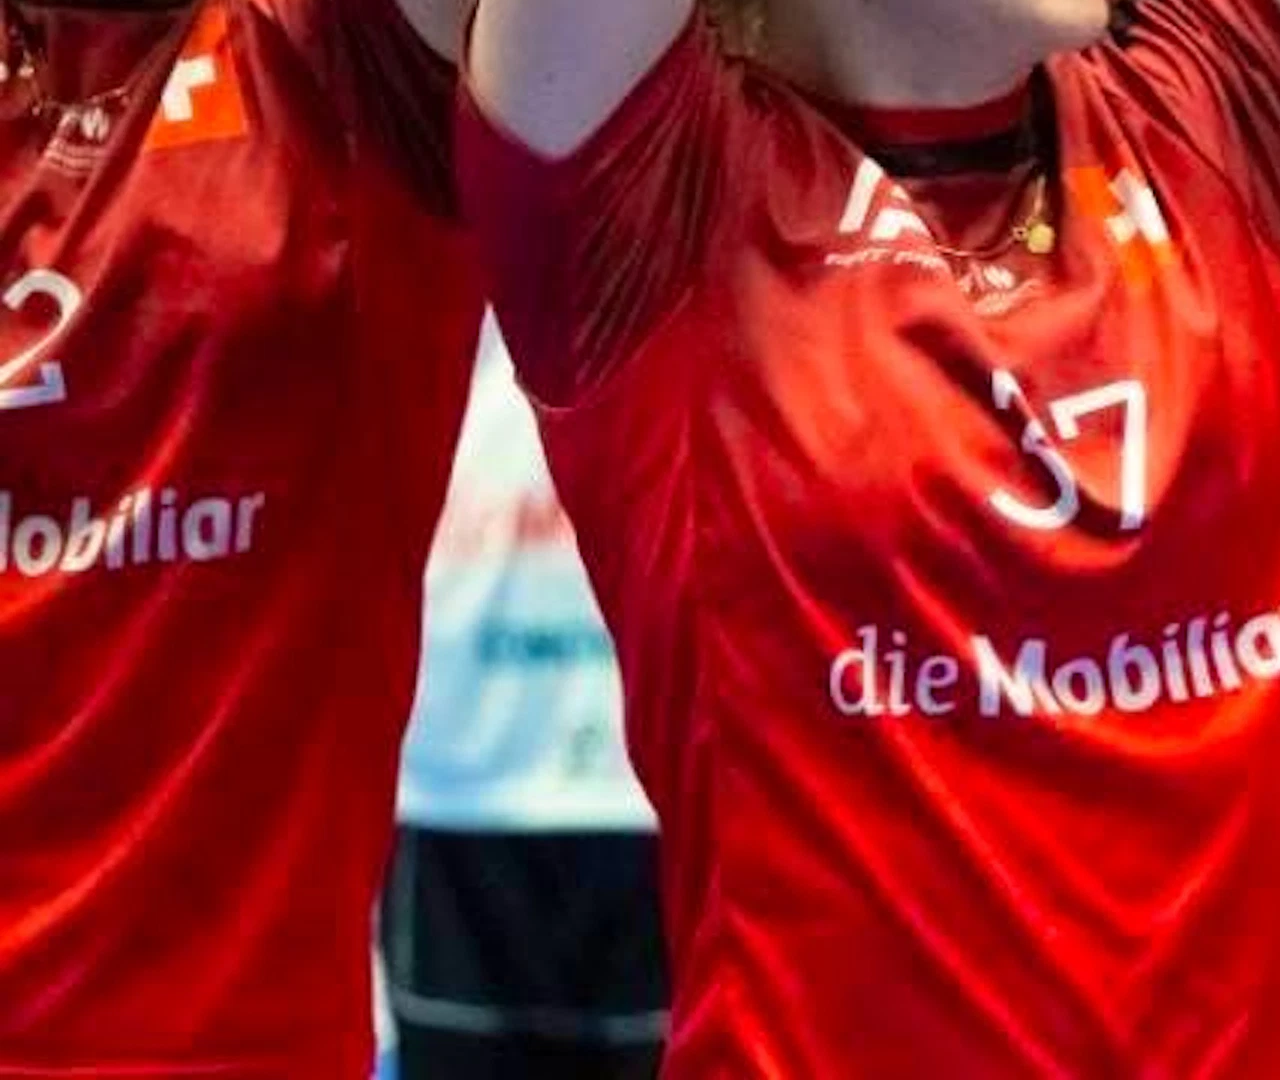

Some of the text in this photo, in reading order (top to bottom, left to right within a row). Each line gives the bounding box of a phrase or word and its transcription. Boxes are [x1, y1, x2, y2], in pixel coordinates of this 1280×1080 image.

[988, 369, 1147, 530] 37
[0, 485, 265, 577] obiliar
[829, 624, 959, 717] die
